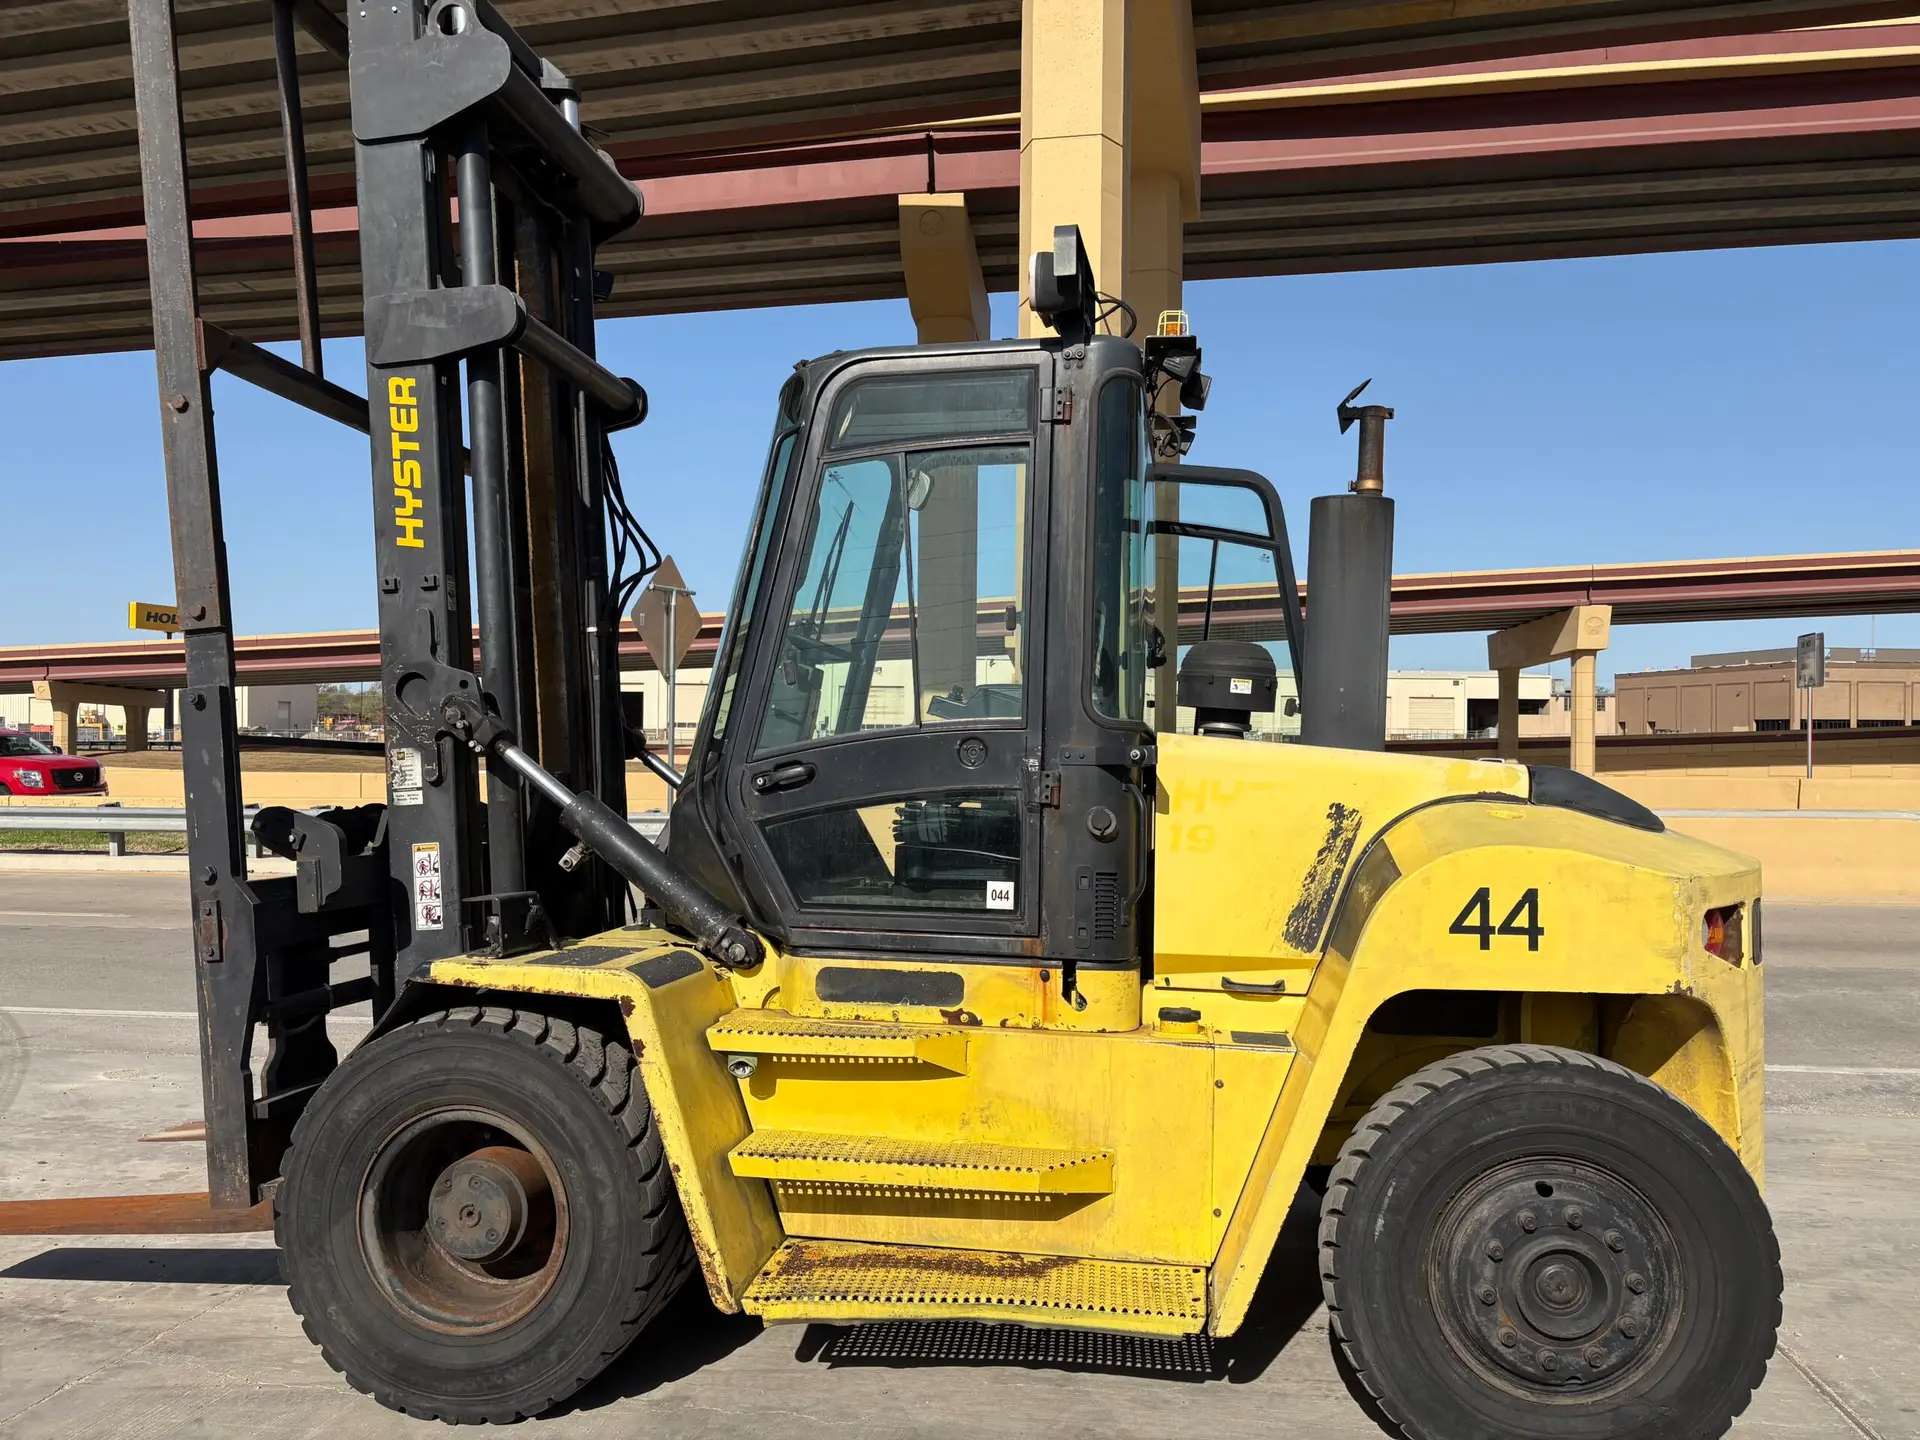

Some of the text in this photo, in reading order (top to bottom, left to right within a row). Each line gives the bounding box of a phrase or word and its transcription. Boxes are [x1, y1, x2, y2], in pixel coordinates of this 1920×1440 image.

[388, 376, 425, 548] HYSTER
[991, 889, 1010, 901] 044
[1448, 887, 1545, 952] 44
